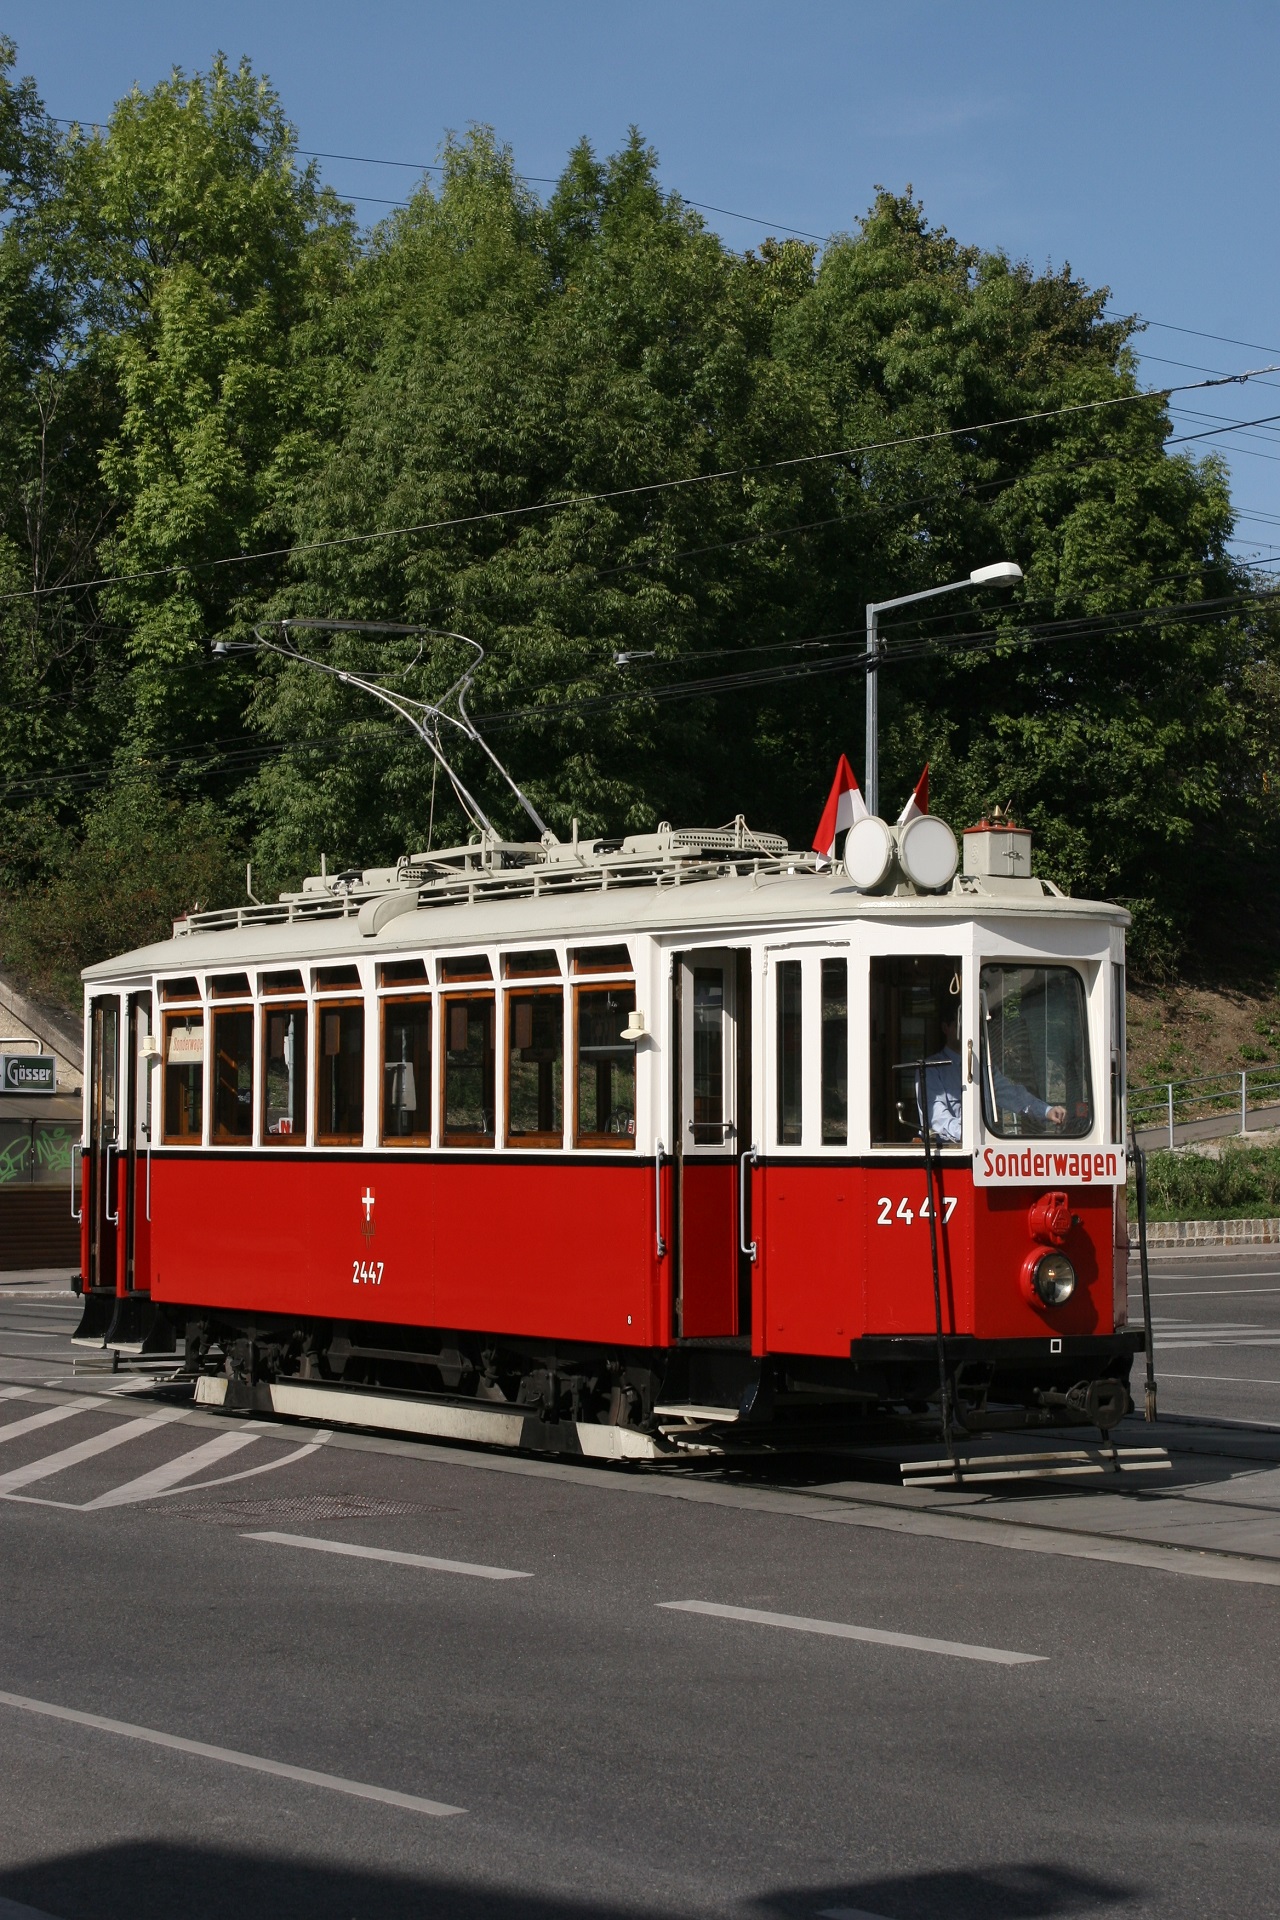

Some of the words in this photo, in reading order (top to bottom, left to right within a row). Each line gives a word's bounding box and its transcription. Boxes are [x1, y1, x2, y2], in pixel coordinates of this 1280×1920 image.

[7, 1059, 51, 1086] Gösser
[983, 1148, 1117, 1182] Sonderwagen
[877, 1197, 957, 1225] 2447
[352, 1261, 384, 1284] 2447
